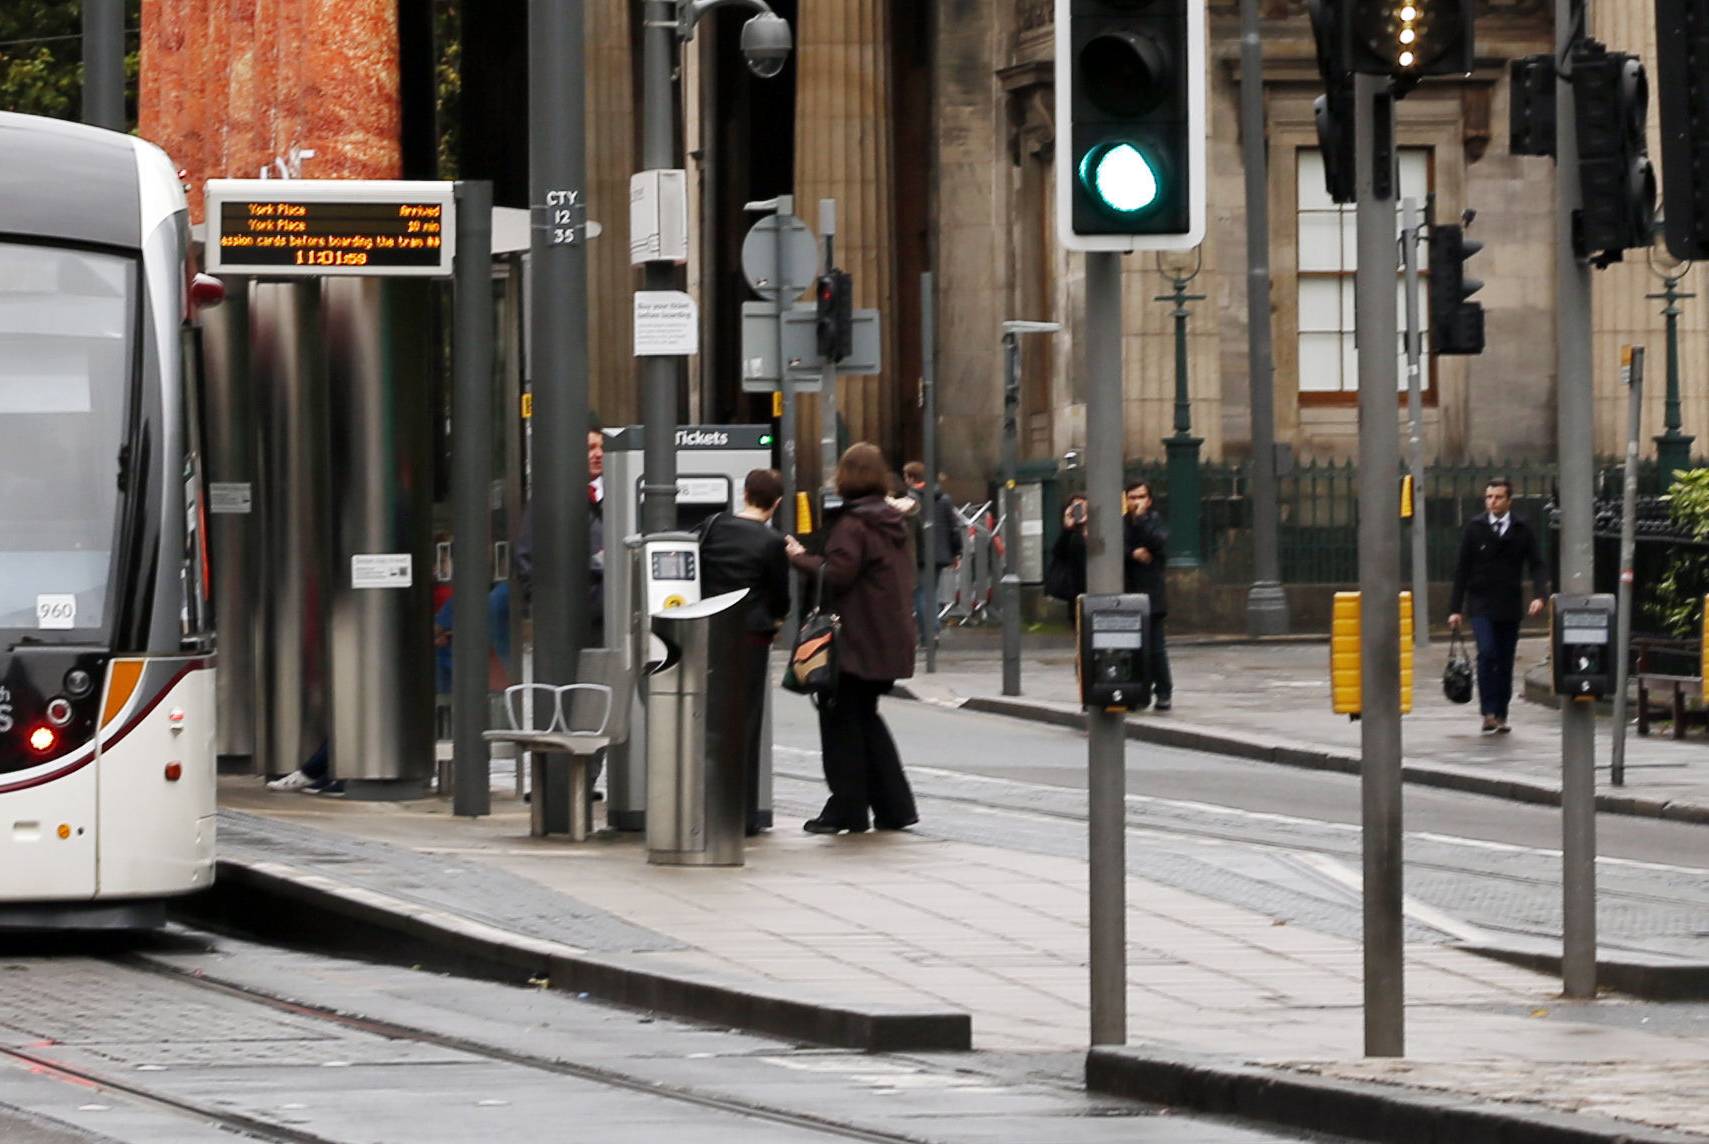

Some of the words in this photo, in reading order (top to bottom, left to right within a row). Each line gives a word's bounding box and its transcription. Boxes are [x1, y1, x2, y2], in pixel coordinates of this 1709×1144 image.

[546, 190, 578, 206] CTY
[248, 203, 275, 216] York
[554, 209, 571, 224] 12
[247, 219, 275, 231] York
[675, 430, 728, 446] Tickets
[40, 603, 73, 619] 960
